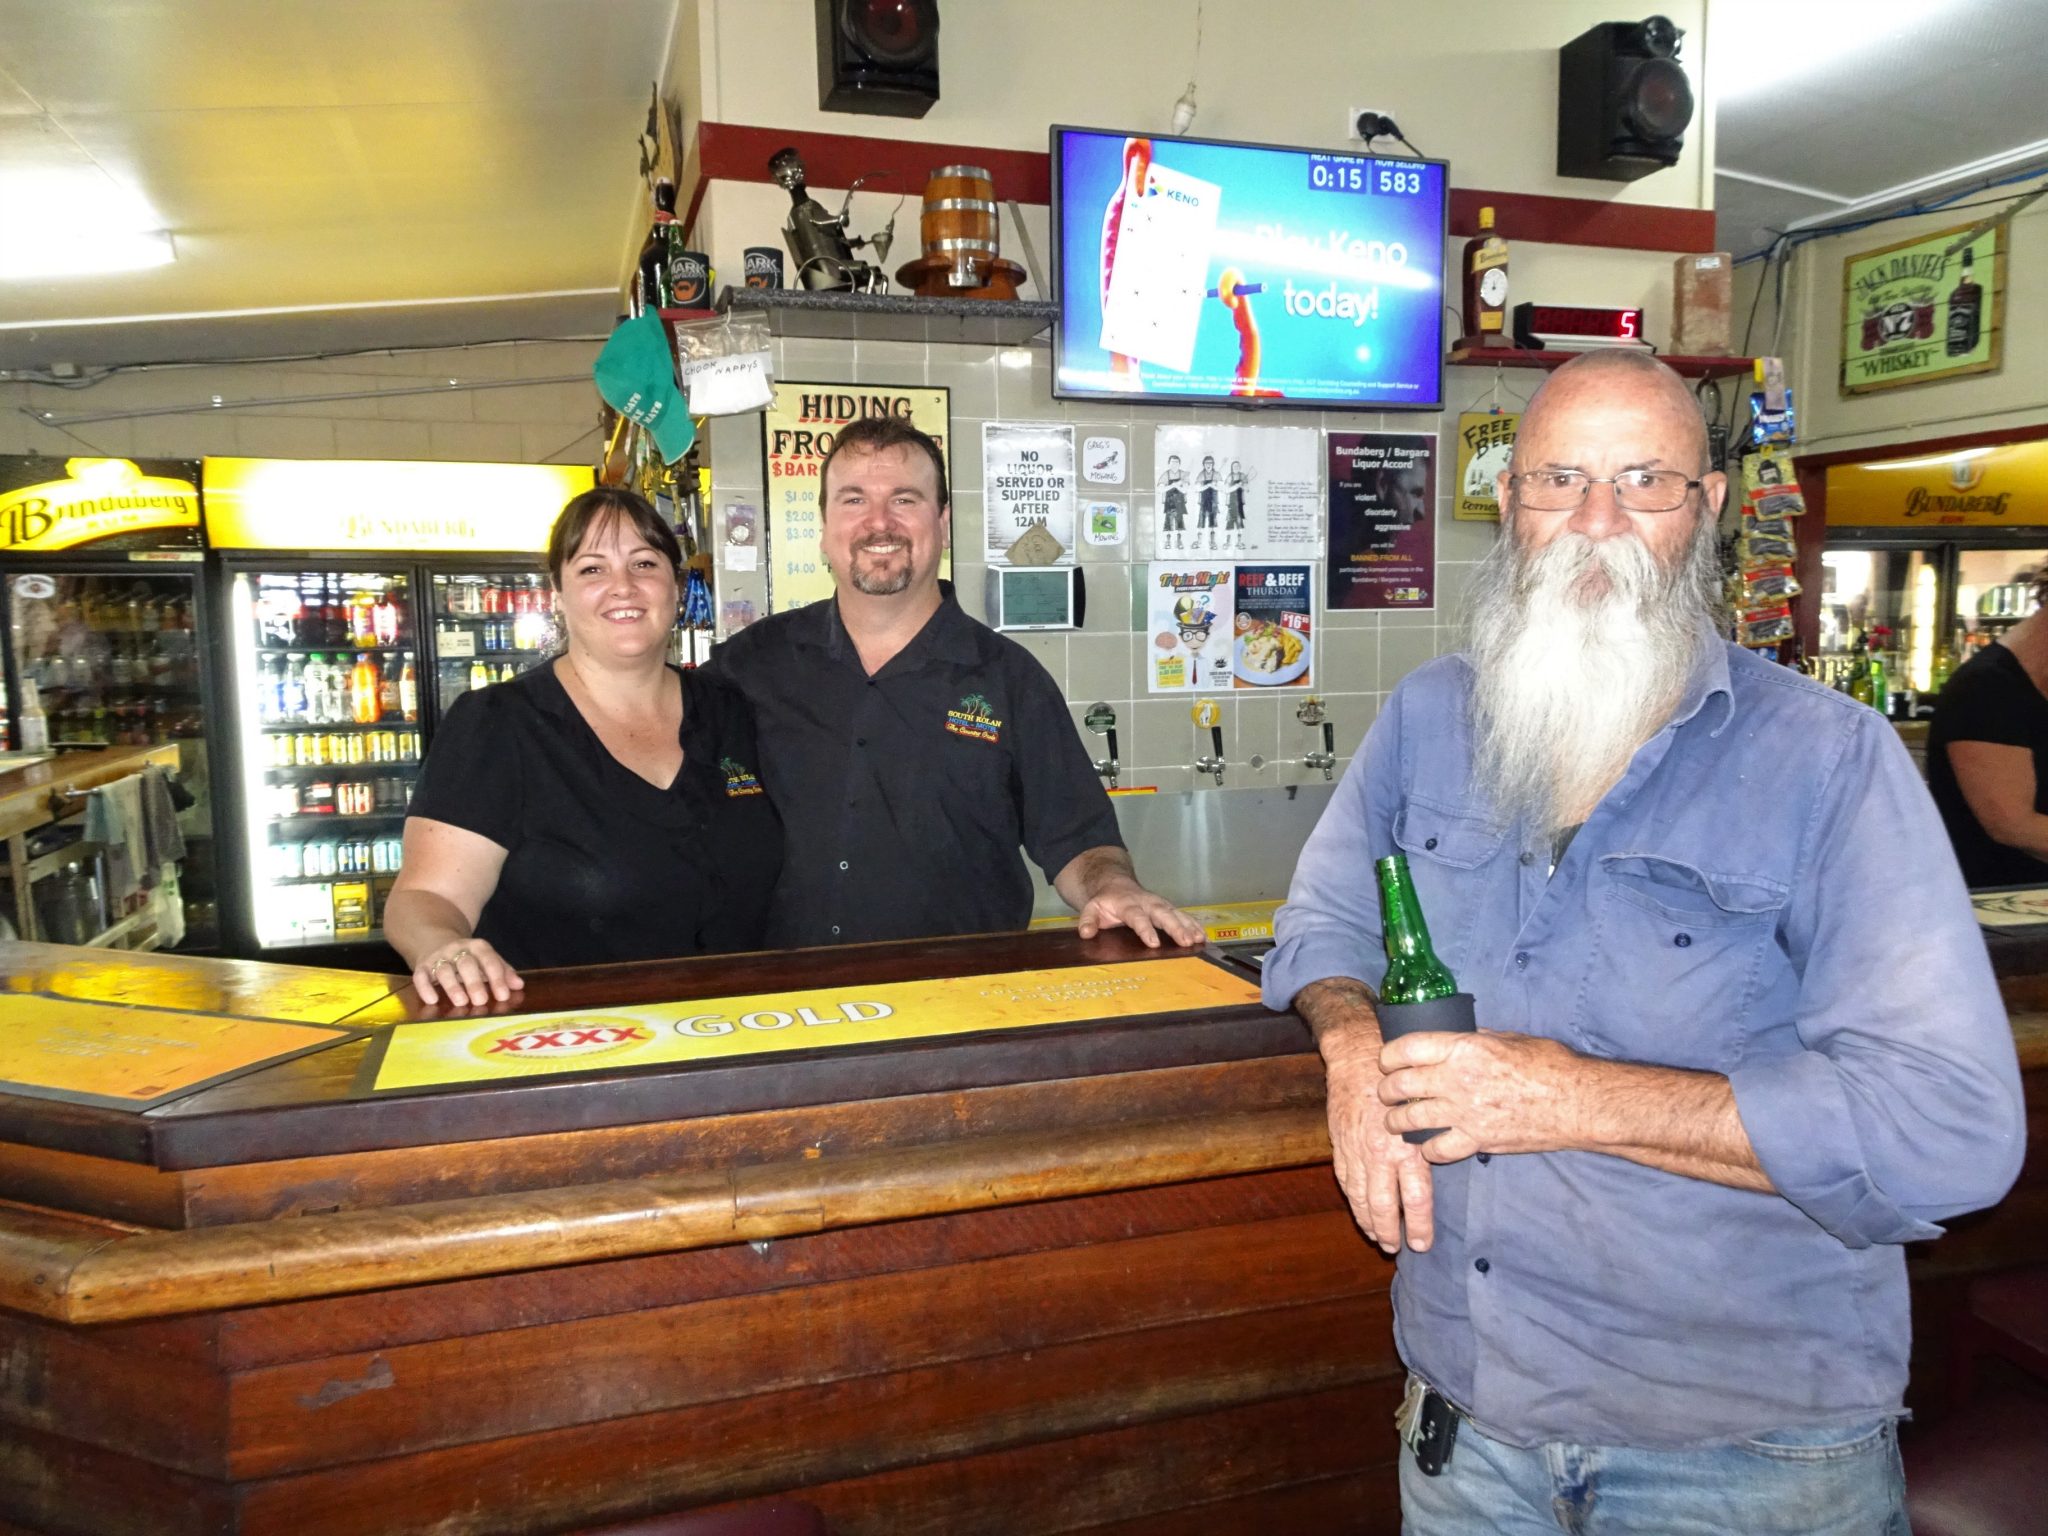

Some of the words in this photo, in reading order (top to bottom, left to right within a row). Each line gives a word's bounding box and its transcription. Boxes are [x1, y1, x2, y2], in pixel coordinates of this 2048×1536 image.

[1313, 165, 1362, 190] 0:15
[1380, 171, 1420, 194] 583
[1167, 189, 1199, 207] KENO
[1328, 229, 1408, 268] Keno
[1283, 278, 1379, 328] today!
[1620, 311, 1636, 338] 5
[684, 361, 717, 376] CHOOK
[715, 359, 758, 376] NAPPYS
[1862, 350, 1931, 376] WHISKEY
[799, 393, 913, 424] HIDING
[1463, 418, 1513, 449] FREE
[770, 429, 836, 460] FRO
[1020, 450, 1039, 462] NO
[1335, 446, 1385, 458] Bundaberg
[1386, 447, 1392, 458] /
[1394, 447, 1430, 459] Bargara
[1007, 463, 1054, 476] LIQUOR
[1352, 458, 1381, 470] Liquor
[1382, 459, 1413, 469] Accord
[996, 476, 1044, 488] SERVED
[1047, 477, 1065, 488] OR
[785, 490, 814, 503] $1.00
[1002, 490, 1060, 502] SUPPLIED
[1354, 494, 1377, 502] violent
[1904, 486, 2012, 518] BUNDABERG
[1012, 503, 1050, 515] AFTER
[1364, 508, 1398, 518] disorderly
[785, 511, 815, 523] $2.00
[1014, 516, 1048, 528] 12AM
[786, 528, 815, 540] $3.00
[1374, 523, 1411, 532] aggressive
[1350, 554, 1379, 562] BANNED
[786, 562, 816, 575] $4.00
[1160, 572, 1195, 587] Trivia
[1196, 571, 1231, 587] Night
[1238, 573, 1265, 587] REEF
[1265, 573, 1277, 587] &
[1278, 573, 1305, 587] BEEF
[1246, 587, 1298, 596] THURSDAY
[947, 710, 974, 722] SOUTH
[976, 716, 1002, 728] KOLAN
[948, 717, 969, 727] HOTEL
[1241, 927, 1268, 937] GOLD
[486, 1026, 648, 1055] XXXX
[673, 1001, 896, 1038] GOLD
